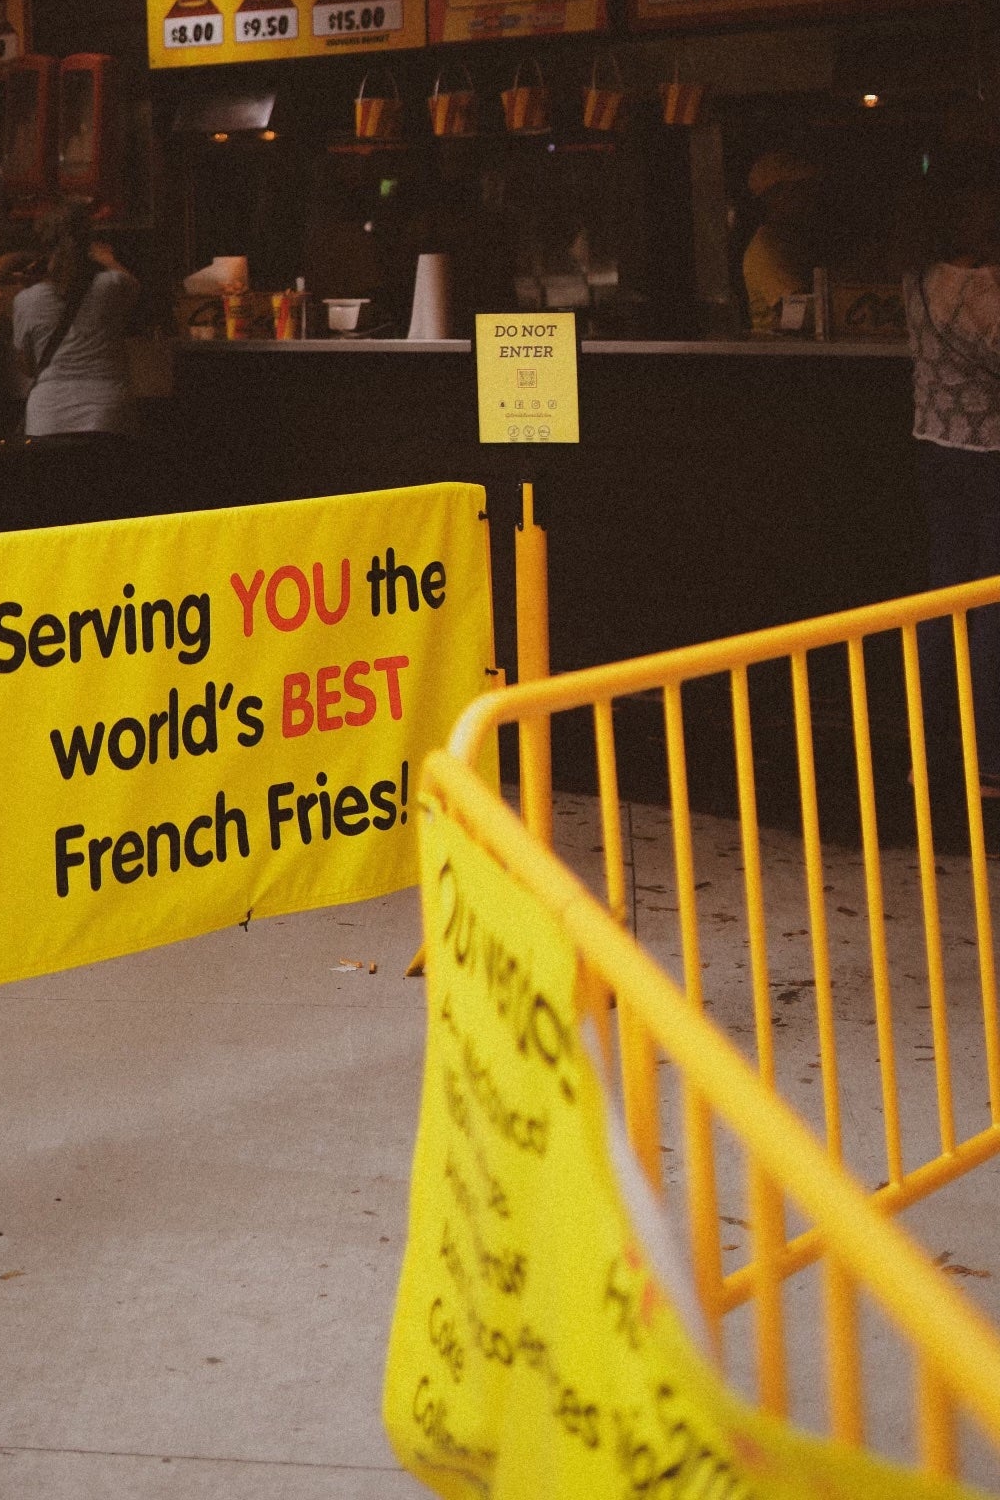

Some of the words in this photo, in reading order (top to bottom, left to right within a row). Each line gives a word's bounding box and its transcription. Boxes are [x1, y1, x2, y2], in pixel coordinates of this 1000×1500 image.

[243, 14, 290, 37] $9.50
[329, 6, 385, 31] $15.00
[171, 22, 214, 44] $8.00
[494, 325, 518, 337] DO
[521, 325, 557, 337] NOT
[499, 346, 554, 358] ENTER
[230, 558, 351, 638] YOU
[366, 546, 447, 618] the
[49, 681, 266, 780] world's
[281, 655, 410, 739] BEST
[54, 790, 251, 898] French
[267, 760, 409, 851] Fries!
